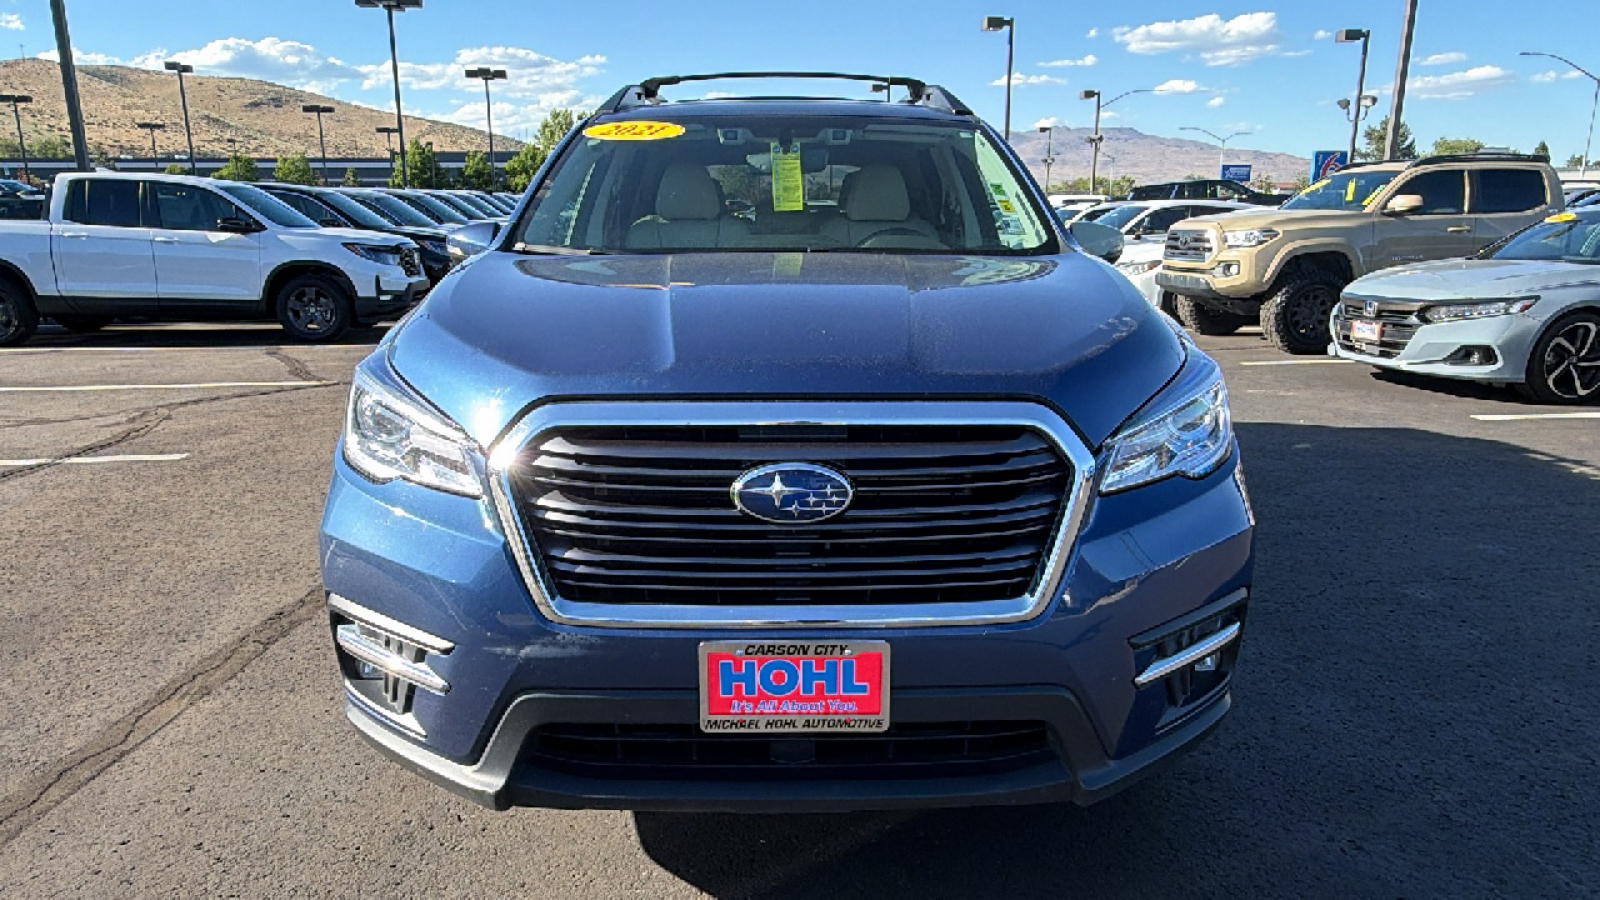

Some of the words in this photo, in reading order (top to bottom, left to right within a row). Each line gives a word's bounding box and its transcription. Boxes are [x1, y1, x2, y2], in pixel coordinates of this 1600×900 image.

[599, 124, 670, 136] 2021
[744, 644, 810, 656] CARSON
[813, 644, 849, 656] CITY
[718, 659, 870, 697] HOHL
[730, 700, 753, 713] It's
[757, 700, 777, 712] All
[779, 700, 825, 712] About
[828, 699, 858, 712] You.
[704, 718, 761, 730] MICHAEL
[764, 718, 799, 729] HOHL
[802, 718, 885, 729] AUTOMOTIVE
